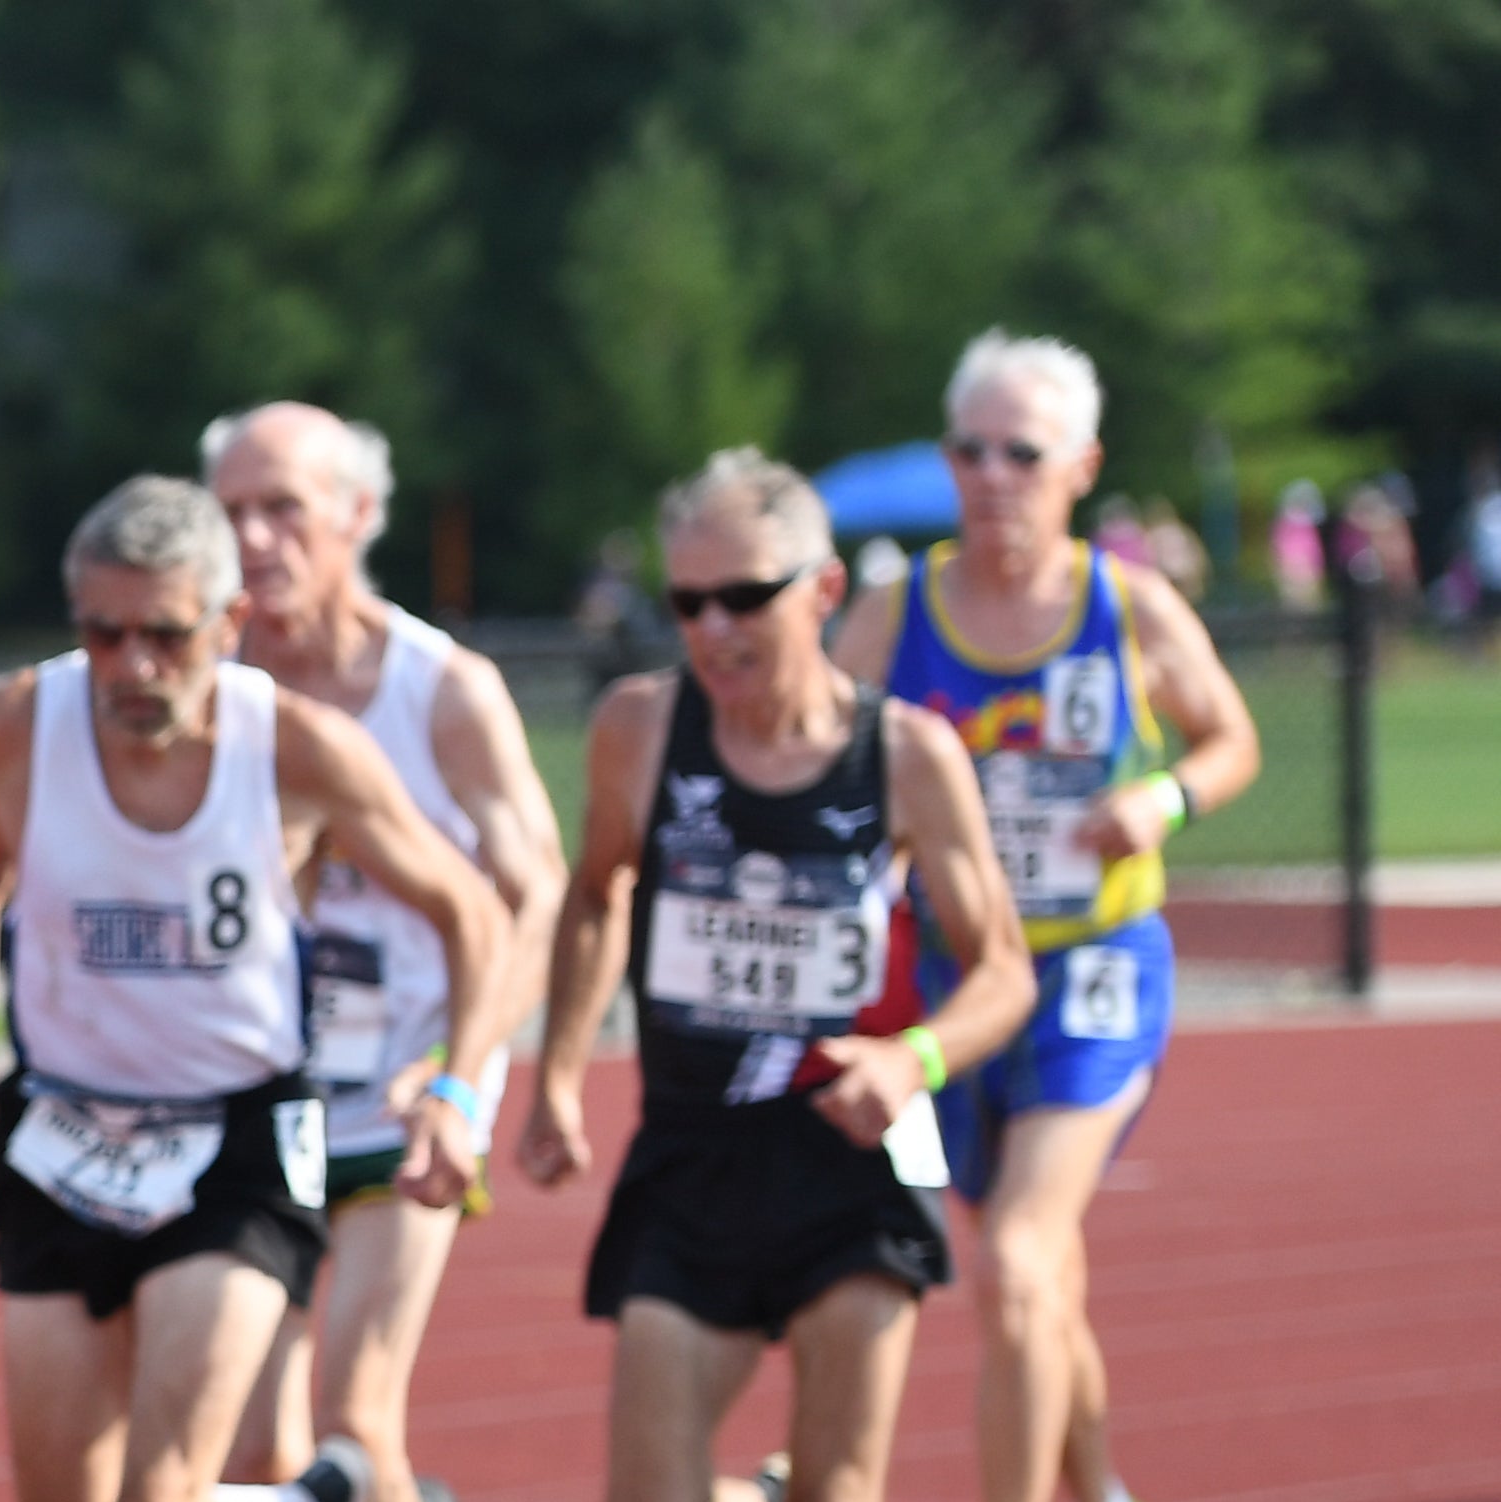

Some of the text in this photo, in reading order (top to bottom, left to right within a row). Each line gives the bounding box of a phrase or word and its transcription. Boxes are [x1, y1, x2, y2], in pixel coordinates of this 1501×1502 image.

[1063, 666, 1099, 736] 6
[210, 871, 247, 950] 8
[832, 914, 869, 998] 3
[1085, 965, 1118, 1022] 6
